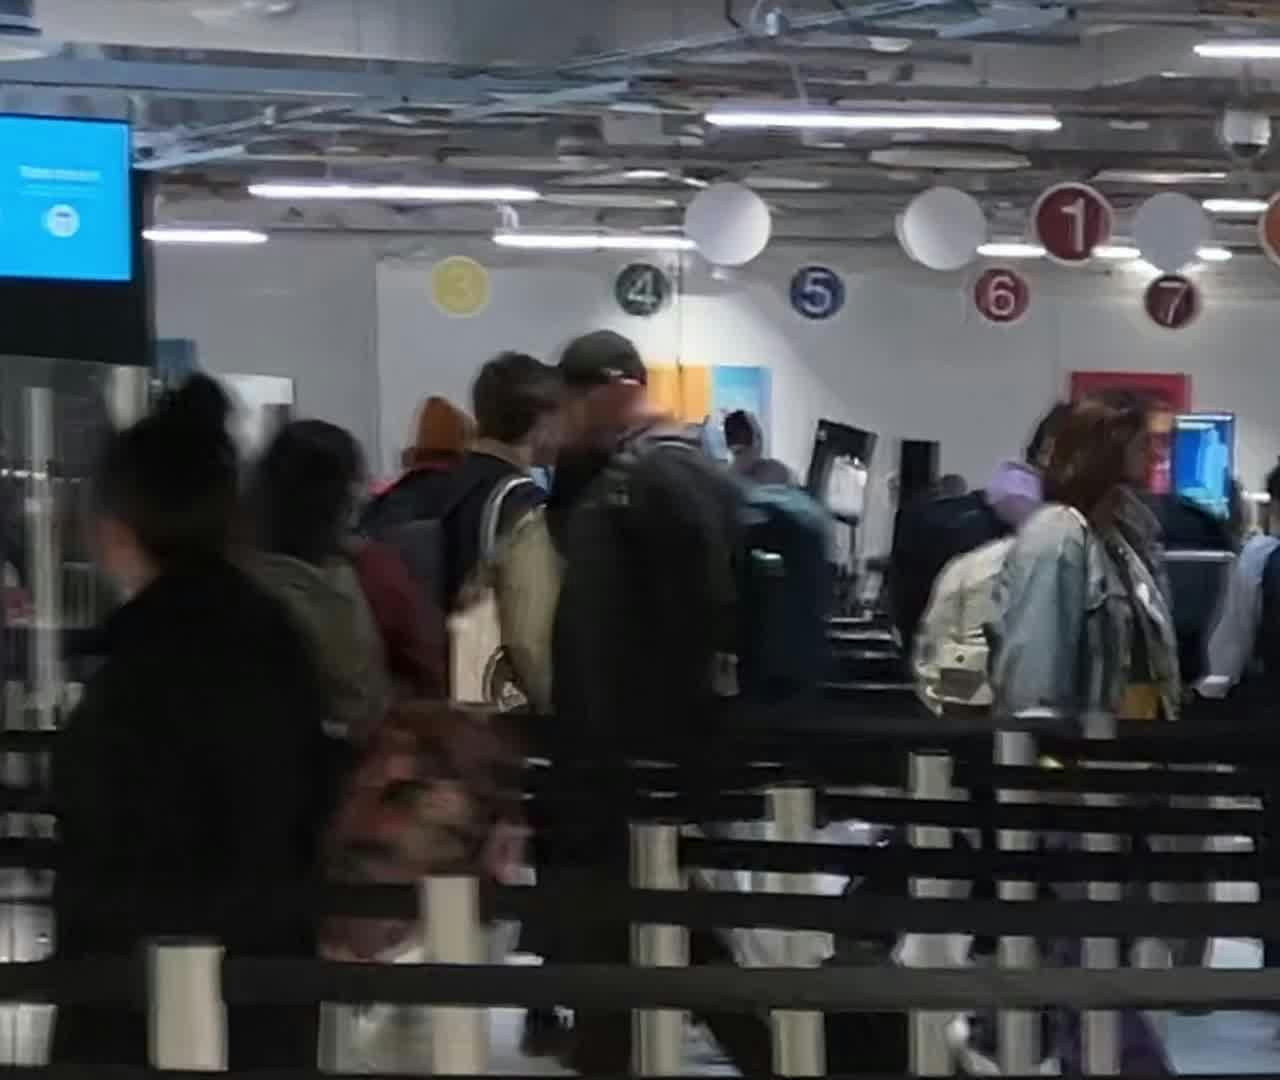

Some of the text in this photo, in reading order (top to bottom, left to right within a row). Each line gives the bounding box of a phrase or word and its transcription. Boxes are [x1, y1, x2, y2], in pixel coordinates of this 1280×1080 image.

[1061, 198, 1085, 252] 1
[627, 271, 658, 306] 4
[802, 271, 831, 314] 5
[990, 276, 1015, 316] 6
[1158, 281, 1189, 324] 7
